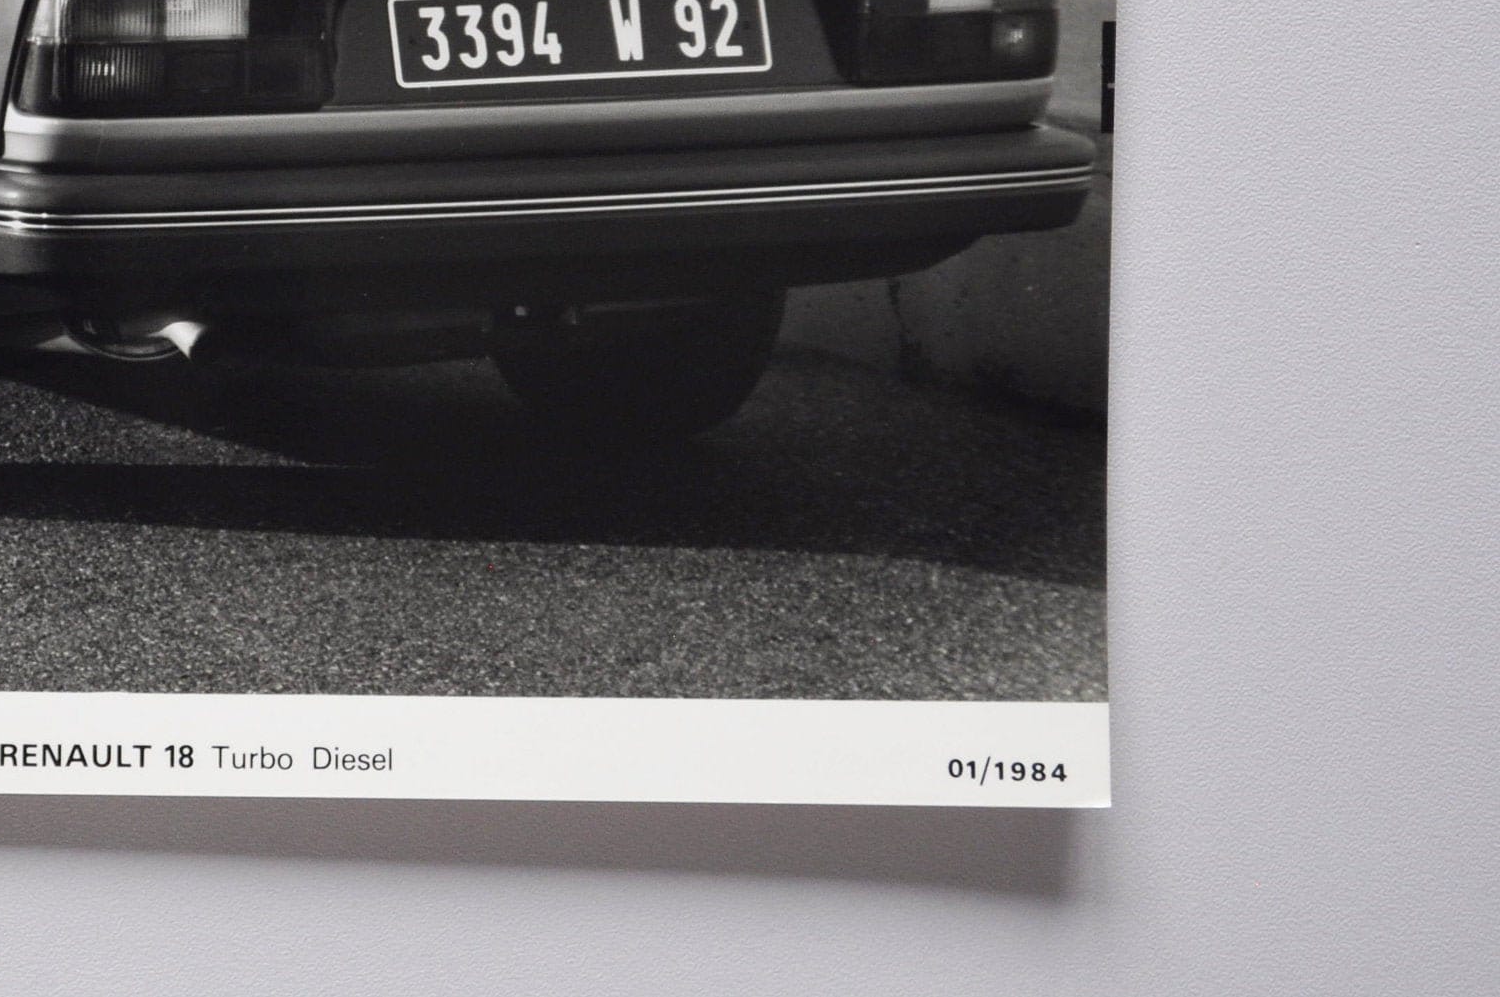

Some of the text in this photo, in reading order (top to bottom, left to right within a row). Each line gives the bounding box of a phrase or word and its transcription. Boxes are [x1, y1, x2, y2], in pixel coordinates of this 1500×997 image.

[418, 0, 563, 72] 3394
[0, 743, 393, 771] RENAULT 18 Turbo Diesel
[947, 755, 1068, 786] 01/1984
